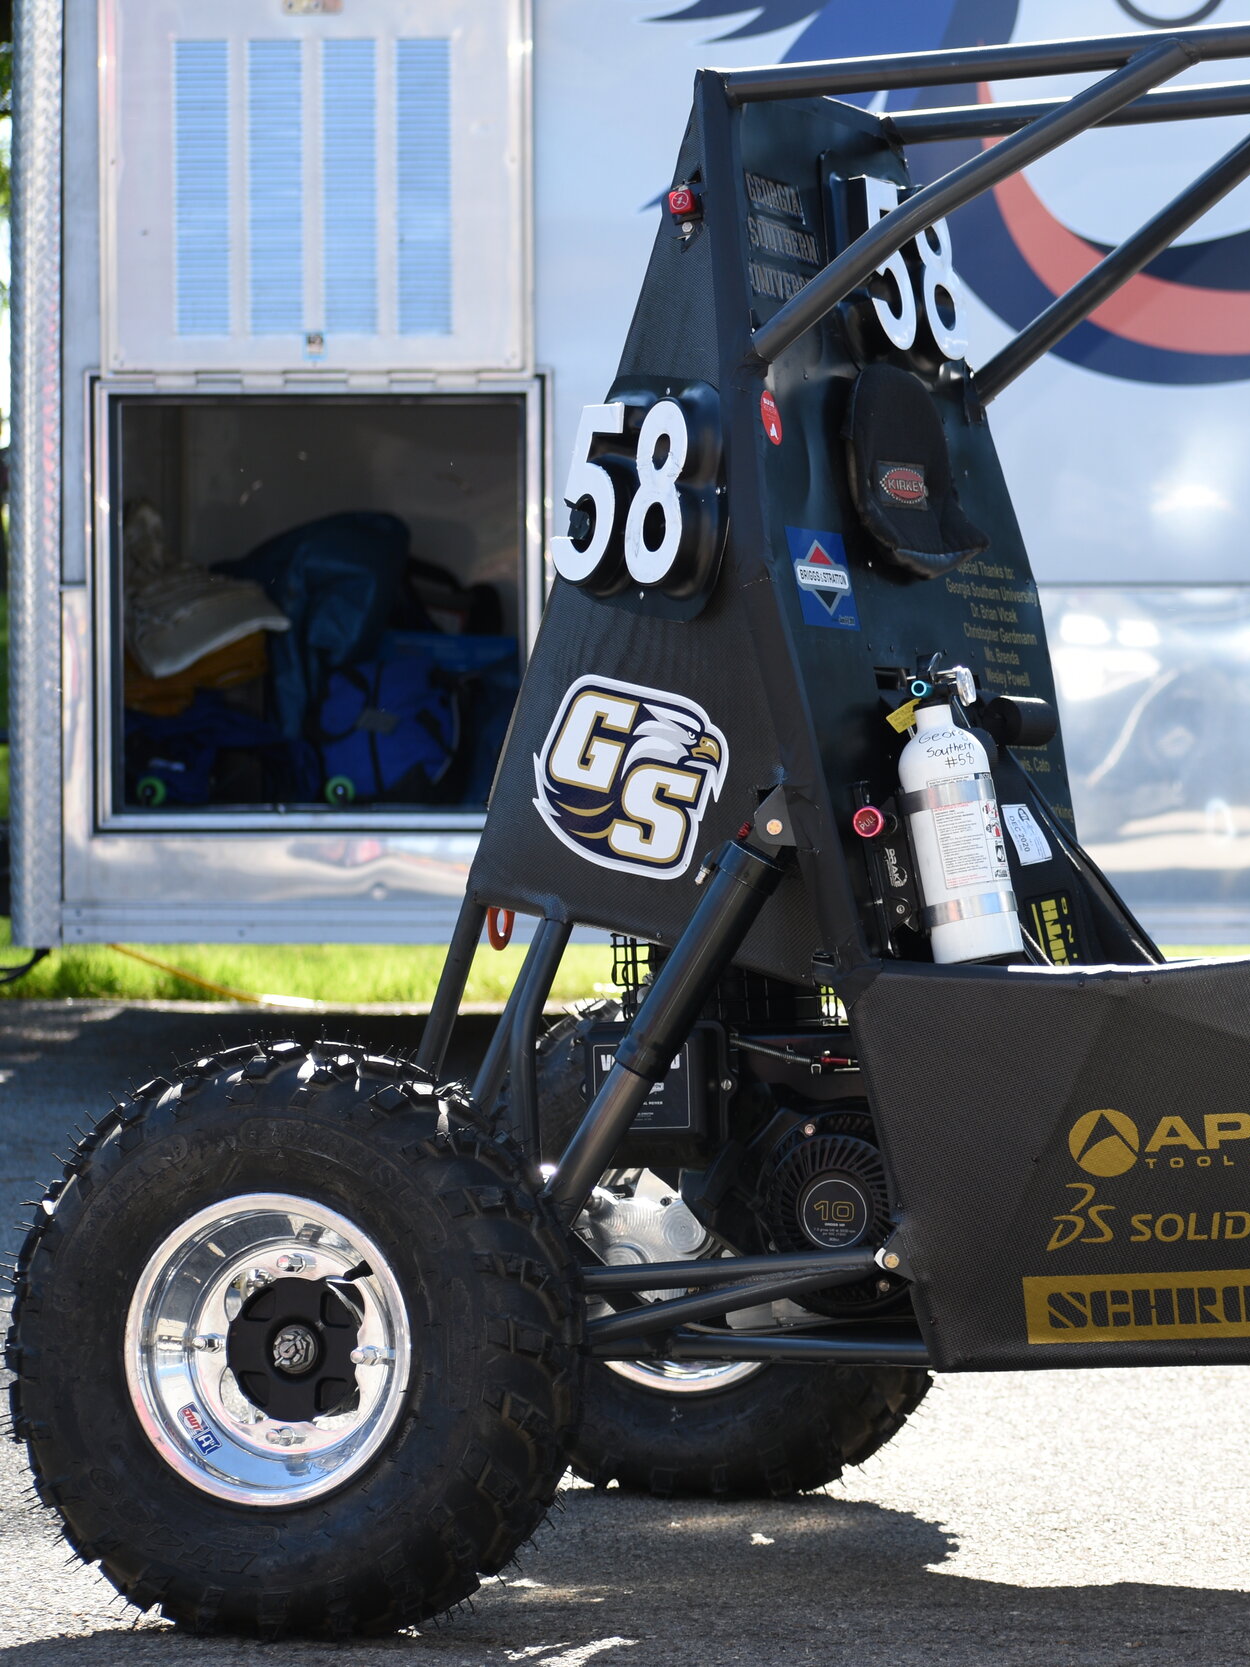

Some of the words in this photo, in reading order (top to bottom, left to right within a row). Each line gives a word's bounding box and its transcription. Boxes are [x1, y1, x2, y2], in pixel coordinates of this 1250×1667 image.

[744, 171, 804, 218] GEORGIA
[747, 216, 820, 266] SOUTHERN
[864, 175, 968, 360] 58
[550, 401, 688, 583] 58
[887, 479, 924, 492] KIRKEY
[945, 578, 971, 599] Georgia
[970, 581, 1001, 600] Southern
[1000, 586, 1038, 607] University
[926, 742, 975, 758] Southern
[944, 752, 975, 768] #58
[860, 815, 877, 831] PULL
[1009, 815, 1021, 832] DEC
[1018, 833, 1031, 852] 2020
[1144, 1155, 1235, 1169] TOOL
[813, 1200, 855, 1222] 10
